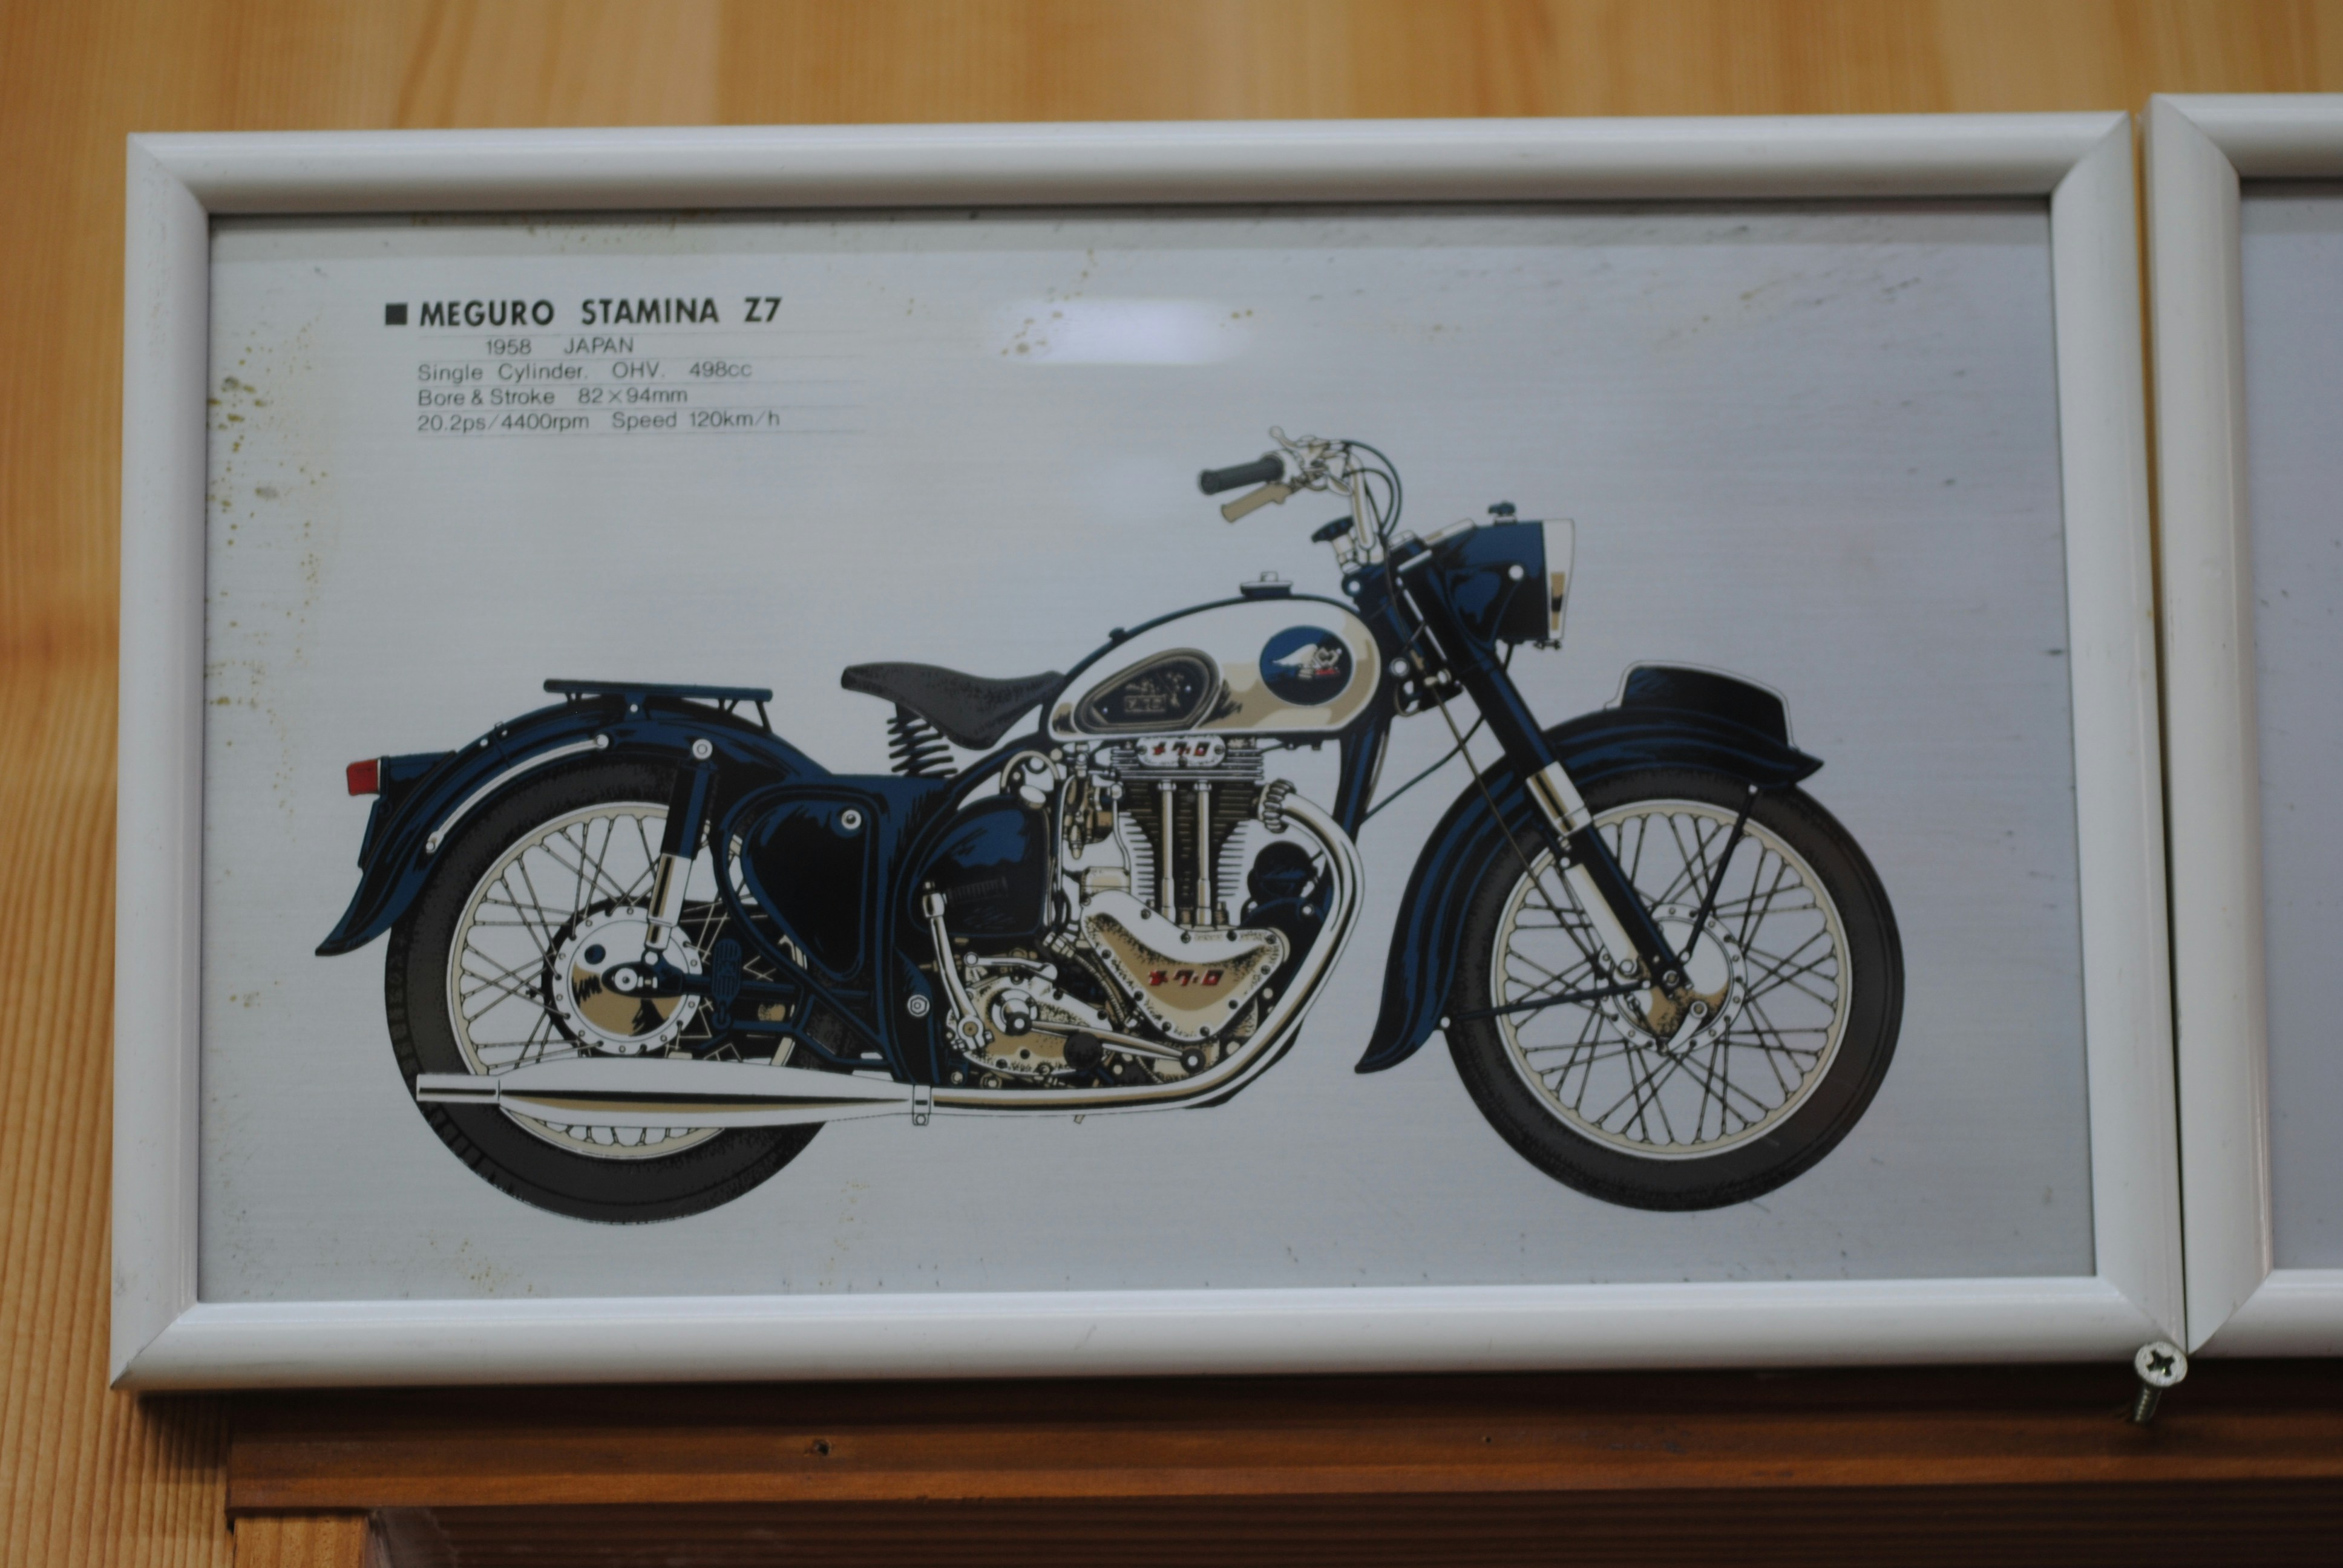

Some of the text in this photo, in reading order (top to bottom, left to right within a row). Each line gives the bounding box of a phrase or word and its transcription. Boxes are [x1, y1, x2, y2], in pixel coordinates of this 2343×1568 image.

[420, 296, 782, 327] MEGURO STAMINA Z7
[487, 337, 634, 355] 1958 JAPAN
[418, 364, 483, 385] Single
[499, 363, 588, 384] Cylinder.
[689, 361, 752, 377] 498cc
[418, 389, 465, 406] Bore
[471, 389, 483, 405] &
[491, 388, 555, 405] Stroke
[418, 410, 780, 433] 20.2ps/4400rpm Speed 120km/h
